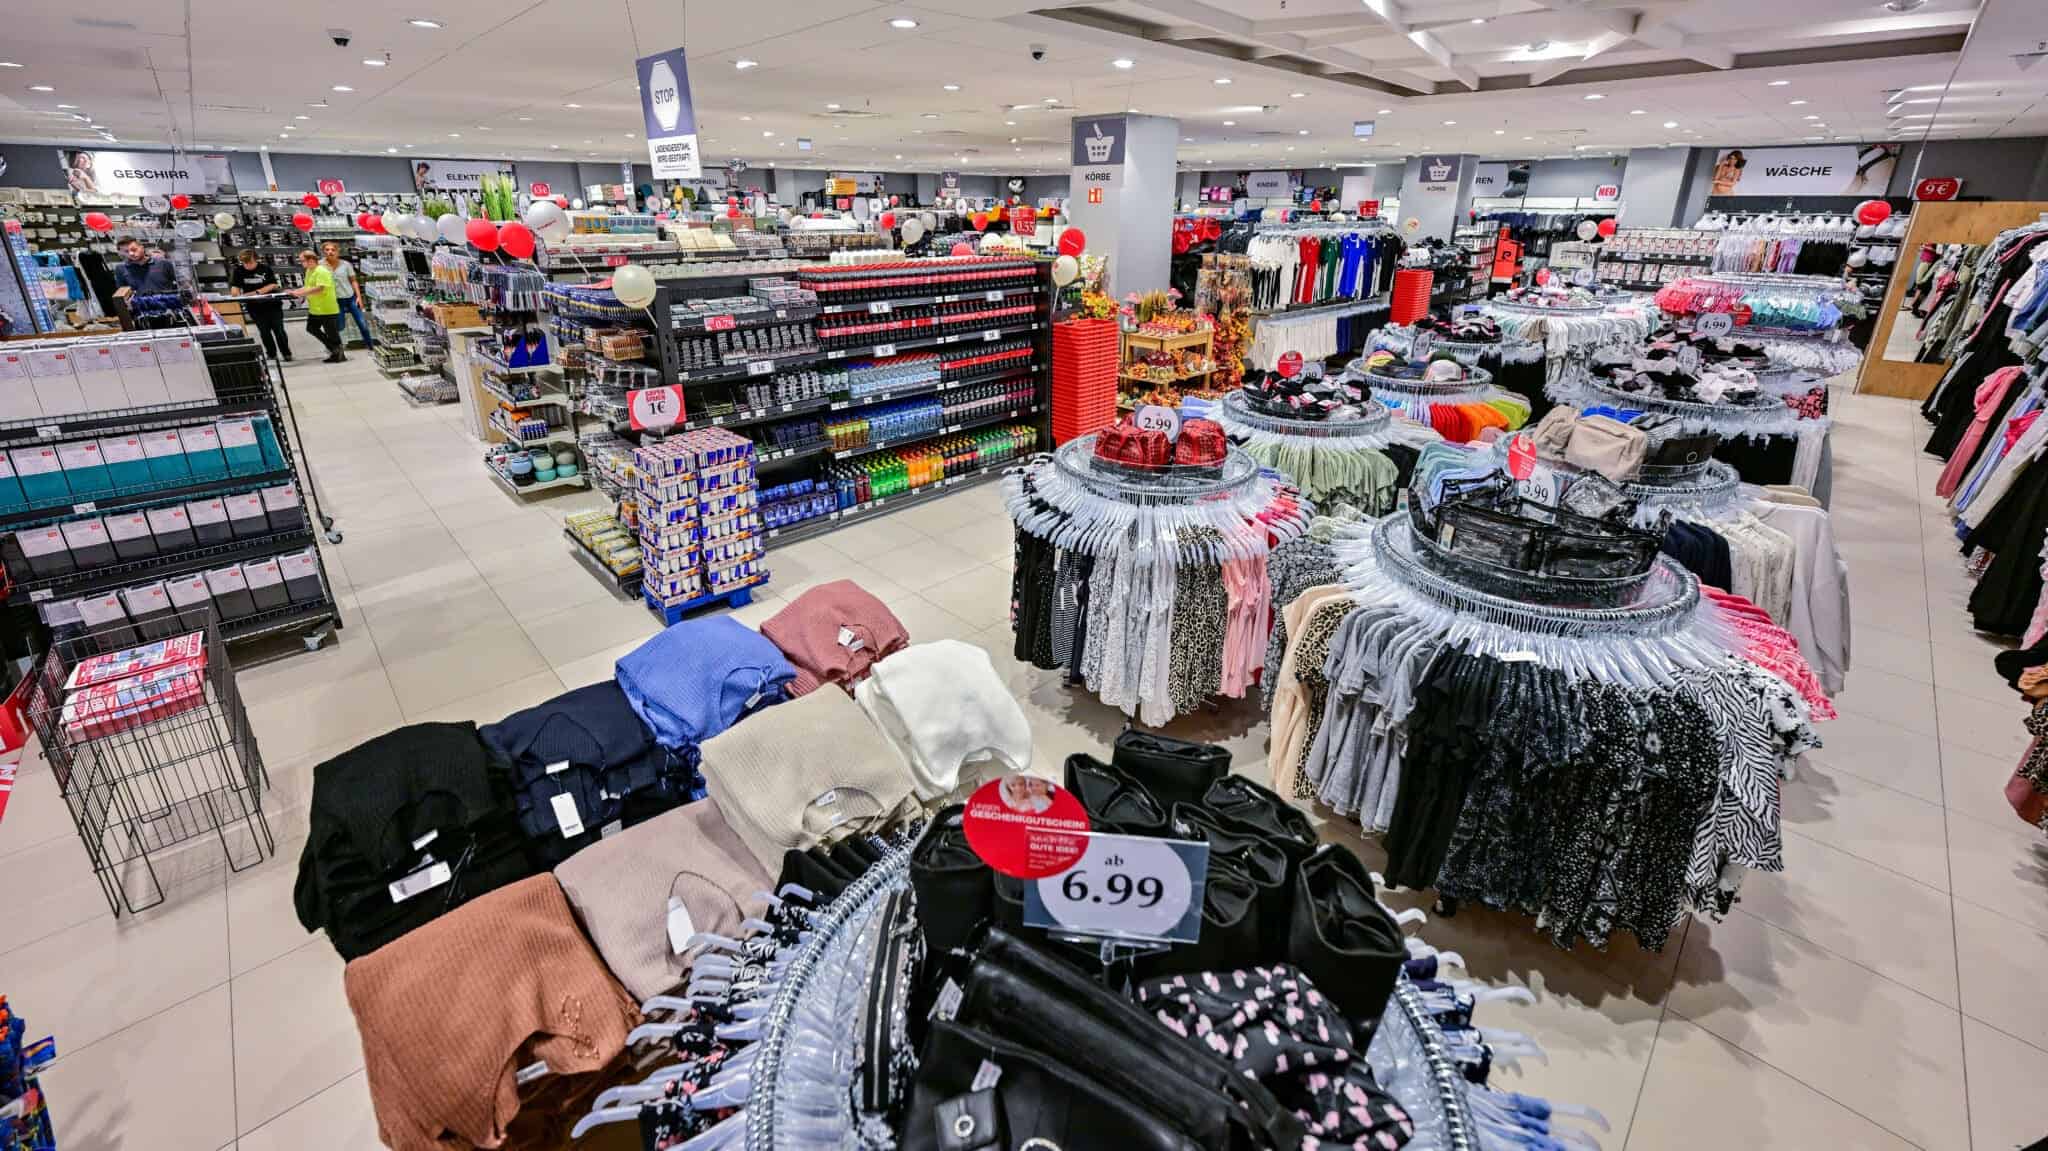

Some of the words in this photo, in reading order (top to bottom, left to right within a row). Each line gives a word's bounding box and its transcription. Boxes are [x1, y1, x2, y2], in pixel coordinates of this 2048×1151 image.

[655, 88, 674, 104] STOP
[113, 169, 189, 179] GESCHIRR
[1085, 172, 1112, 181] KÖRBE
[1765, 165, 1833, 177] WÄSCHE
[649, 401, 665, 415] 1€
[1144, 416, 1172, 430] 2.99
[1104, 855, 1124, 866] ab
[1062, 870, 1164, 908] 6.99
